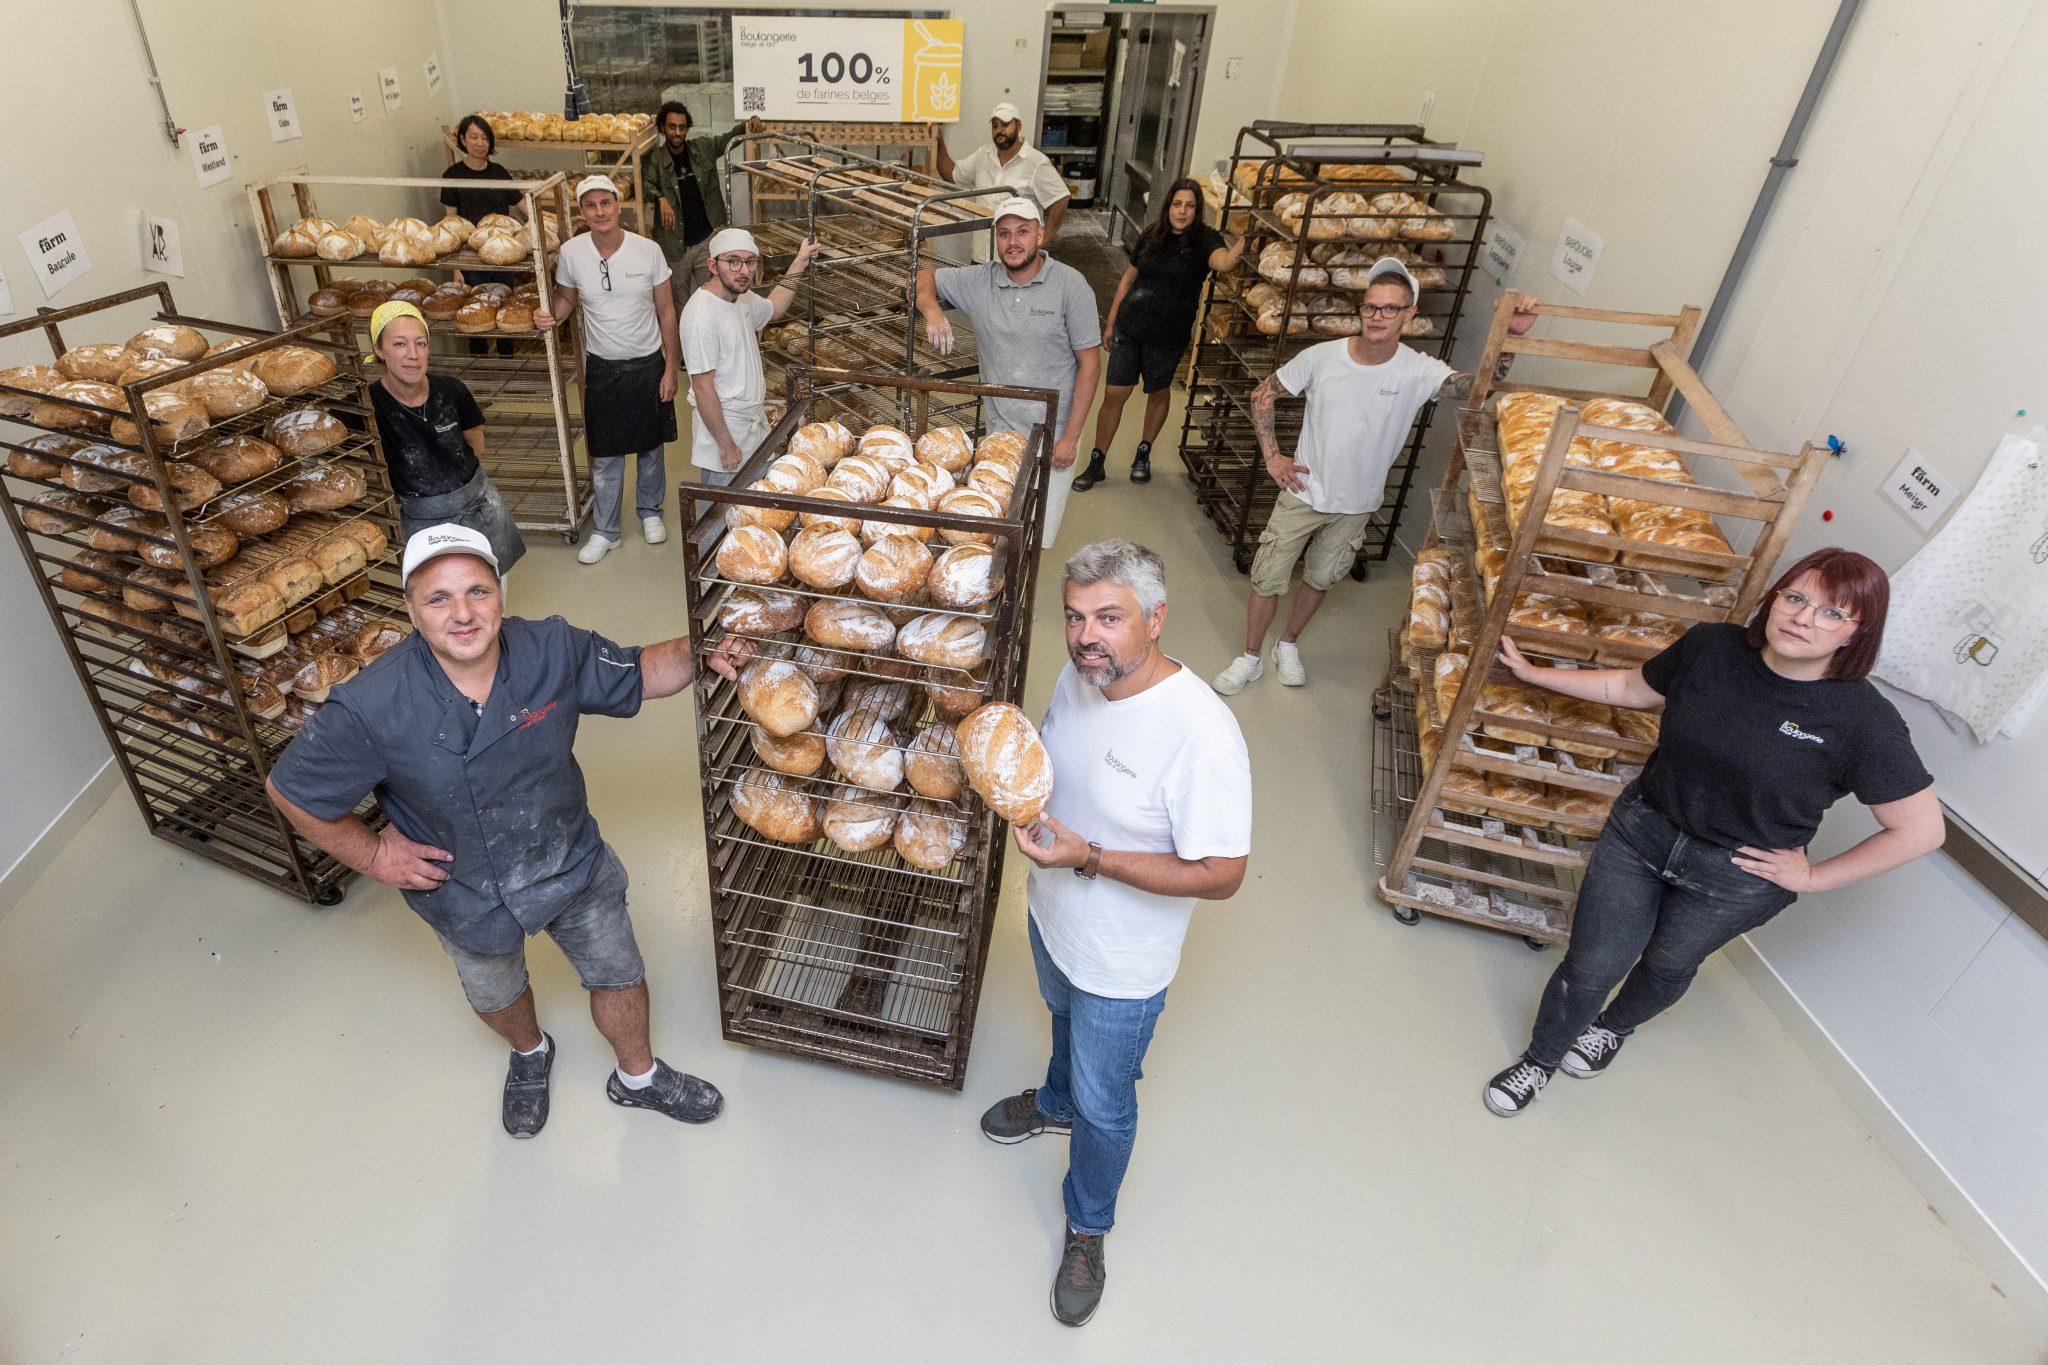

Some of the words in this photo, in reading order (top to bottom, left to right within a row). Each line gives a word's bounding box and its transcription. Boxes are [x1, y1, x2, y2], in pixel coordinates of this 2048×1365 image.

[740, 31, 797, 43] Boulangerie
[796, 88, 810, 99] de
[813, 87, 850, 99] farines
[852, 88, 890, 102] belges
[199, 141, 218, 154] färm
[201, 157, 226, 173] Westland
[38, 232, 67, 254] färm
[47, 251, 76, 275] Bascule
[1563, 253, 1583, 273] Louise
[1910, 466, 1940, 497] färm
[1898, 483, 1928, 511] Meiser
